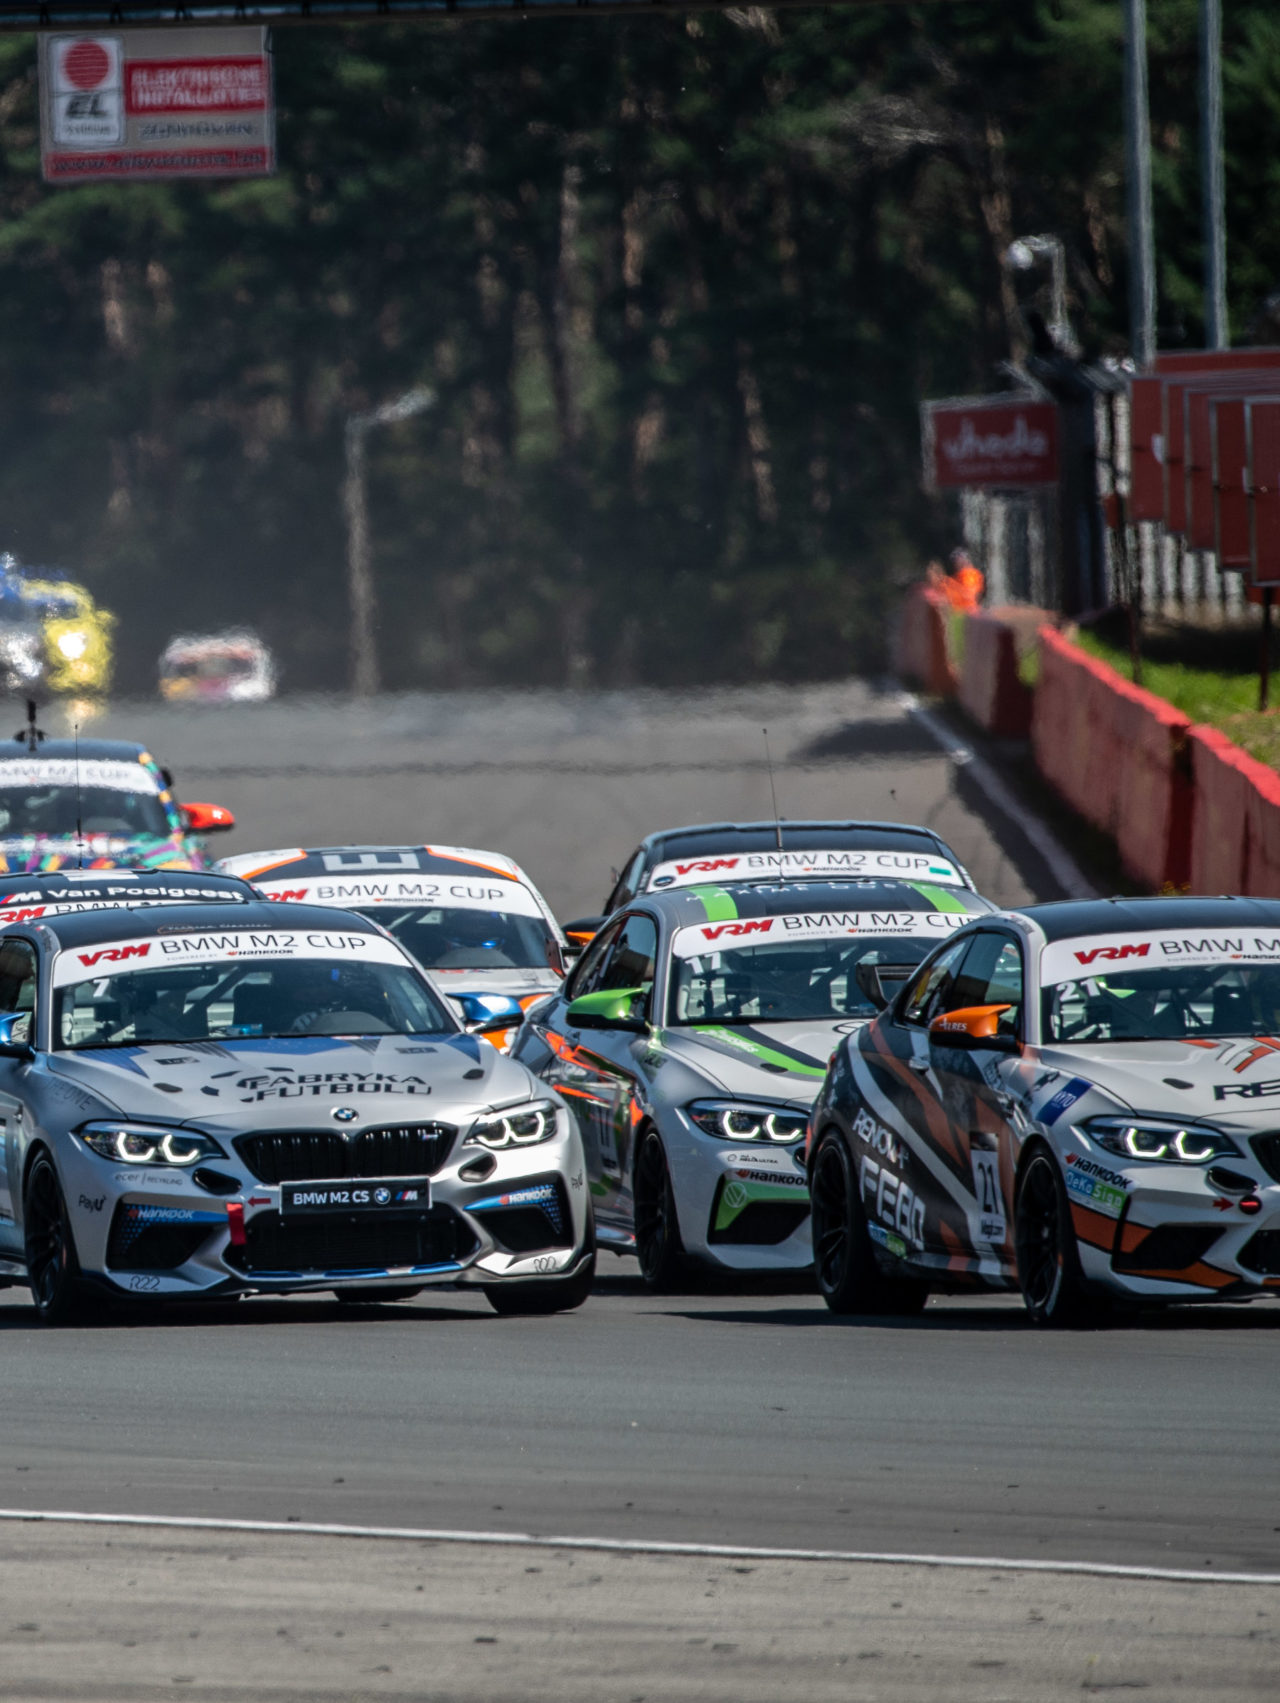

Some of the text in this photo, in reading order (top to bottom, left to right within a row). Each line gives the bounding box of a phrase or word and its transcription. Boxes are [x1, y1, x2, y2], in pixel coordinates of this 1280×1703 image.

[675, 858, 739, 875] VRM
[747, 854, 818, 868] BMW
[827, 854, 867, 866] M2
[877, 855, 930, 869] CUP
[48, 888, 103, 899] Van
[108, 887, 244, 901] Poelgeest
[265, 884, 505, 901] RM BMW M2 CUP
[701, 913, 974, 941] VRM BMW M2 CU
[77, 935, 367, 967] VRM BMW M2 CUP
[1073, 942, 1151, 965] VRM
[1159, 938, 1243, 955] BMW
[92, 978, 110, 998] 7
[1056, 976, 1101, 1002] 21
[250, 1072, 427, 1090] FABRYKA
[256, 1082, 432, 1101] FUTBOLU
[750, 1171, 808, 1186] HanKOO
[293, 1191, 328, 1205] BMW
[330, 1191, 349, 1203] M2
[352, 1190, 370, 1203] CS
